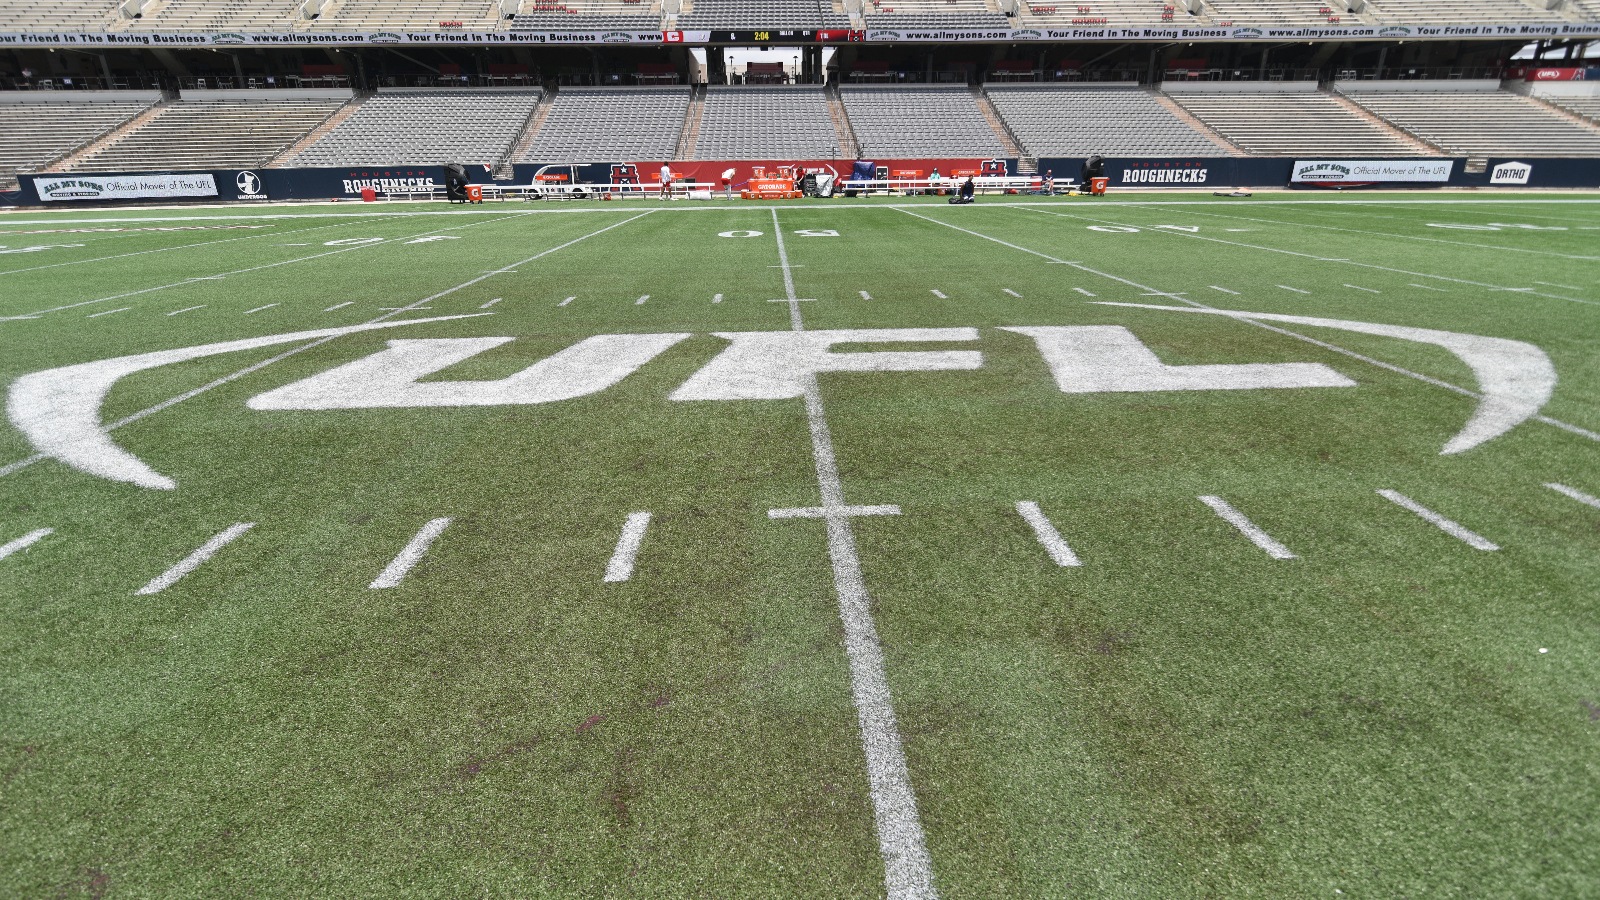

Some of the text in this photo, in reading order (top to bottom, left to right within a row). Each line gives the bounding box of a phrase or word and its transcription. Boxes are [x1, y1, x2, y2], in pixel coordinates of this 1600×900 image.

[1047, 30, 1069, 38] Your
[1143, 30, 1178, 38] Moving
[1182, 29, 1226, 37] Business
[1269, 28, 1373, 37] www.allmysons.com
[1444, 26, 1478, 34] Friend
[1497, 26, 1516, 34] The
[1520, 26, 1557, 35] Moving
[1562, 25, 1600, 33] Busine
[20, 34, 60, 42] Friend
[64, 34, 76, 42] In
[80, 34, 103, 42] The
[106, 34, 150, 44] Moving
[152, 34, 206, 42] Business
[252, 34, 364, 43] www.allmysons.com
[509, 34, 546, 43] Moving
[550, 33, 596, 41] Business
[754, 32, 769, 41] 2:04
[906, 32, 1007, 40] www.allmysons.com
[1299, 165, 1314, 175] ALL
[1331, 164, 1350, 175] SONS
[1354, 166, 1380, 174] Official
[1408, 166, 1417, 175] of
[1495, 169, 1525, 179] ORTHO
[1122, 169, 1207, 182] ROUGHNECKS
[44, 181, 104, 194] ALL MY SONS
[107, 180, 212, 191] Official Mover of The UFL
[343, 178, 435, 193] ROUGHNECKS
[471, 189, 479, 197] G
[247, 325, 1357, 411] UFL
